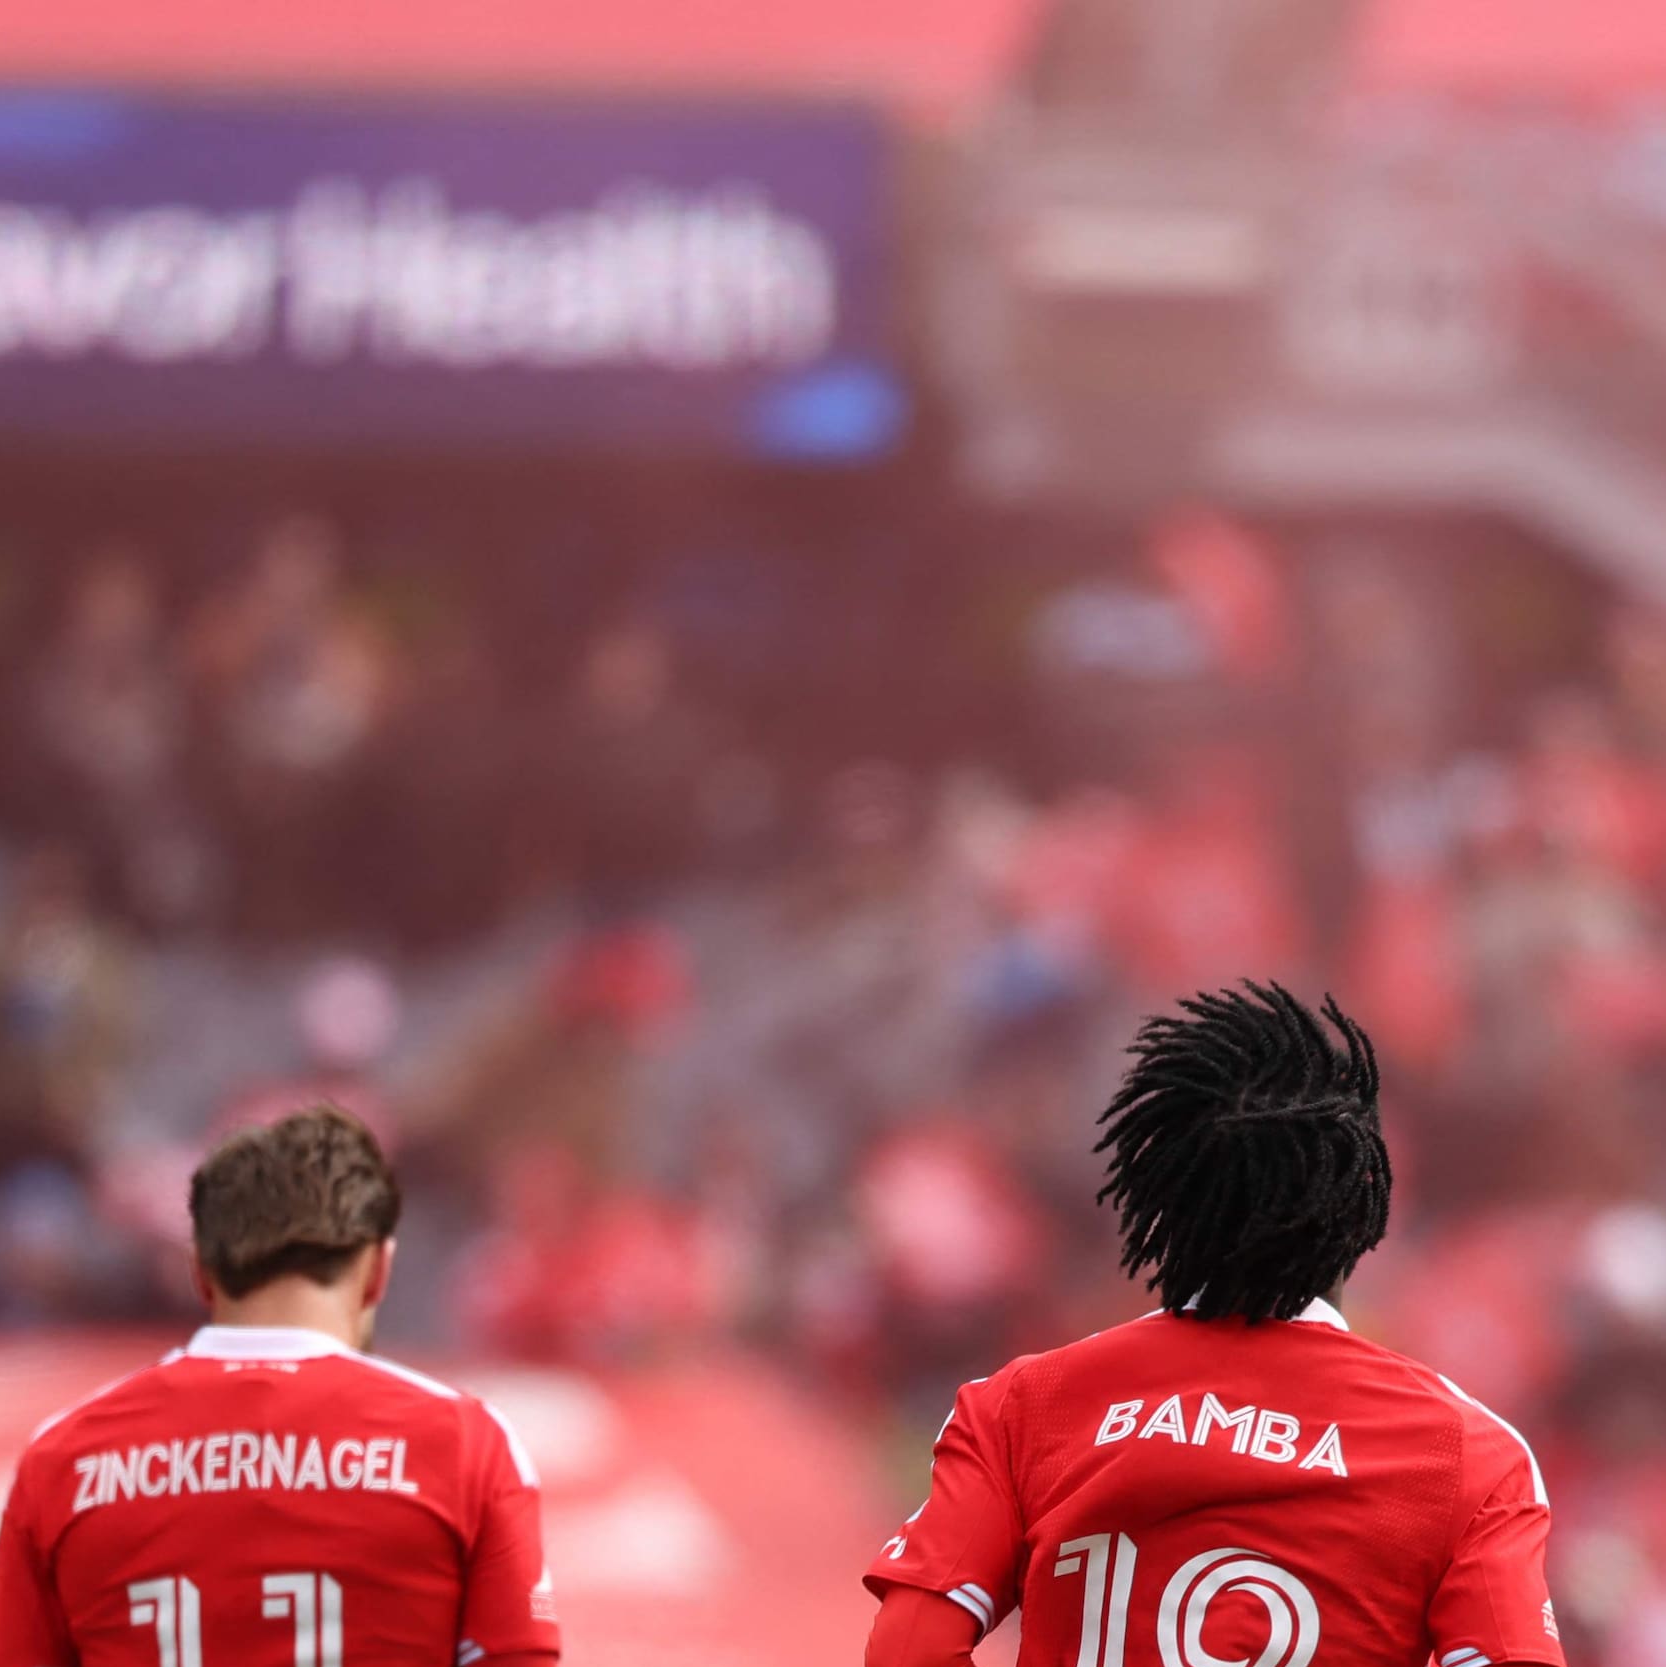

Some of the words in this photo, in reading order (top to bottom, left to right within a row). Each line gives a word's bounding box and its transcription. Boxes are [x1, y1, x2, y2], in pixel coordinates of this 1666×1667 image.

[288, 172, 835, 366] Health
[73, 1431, 419, 1514] ZINCKERNAGEL
[1094, 1392, 1348, 1478] BAMBA
